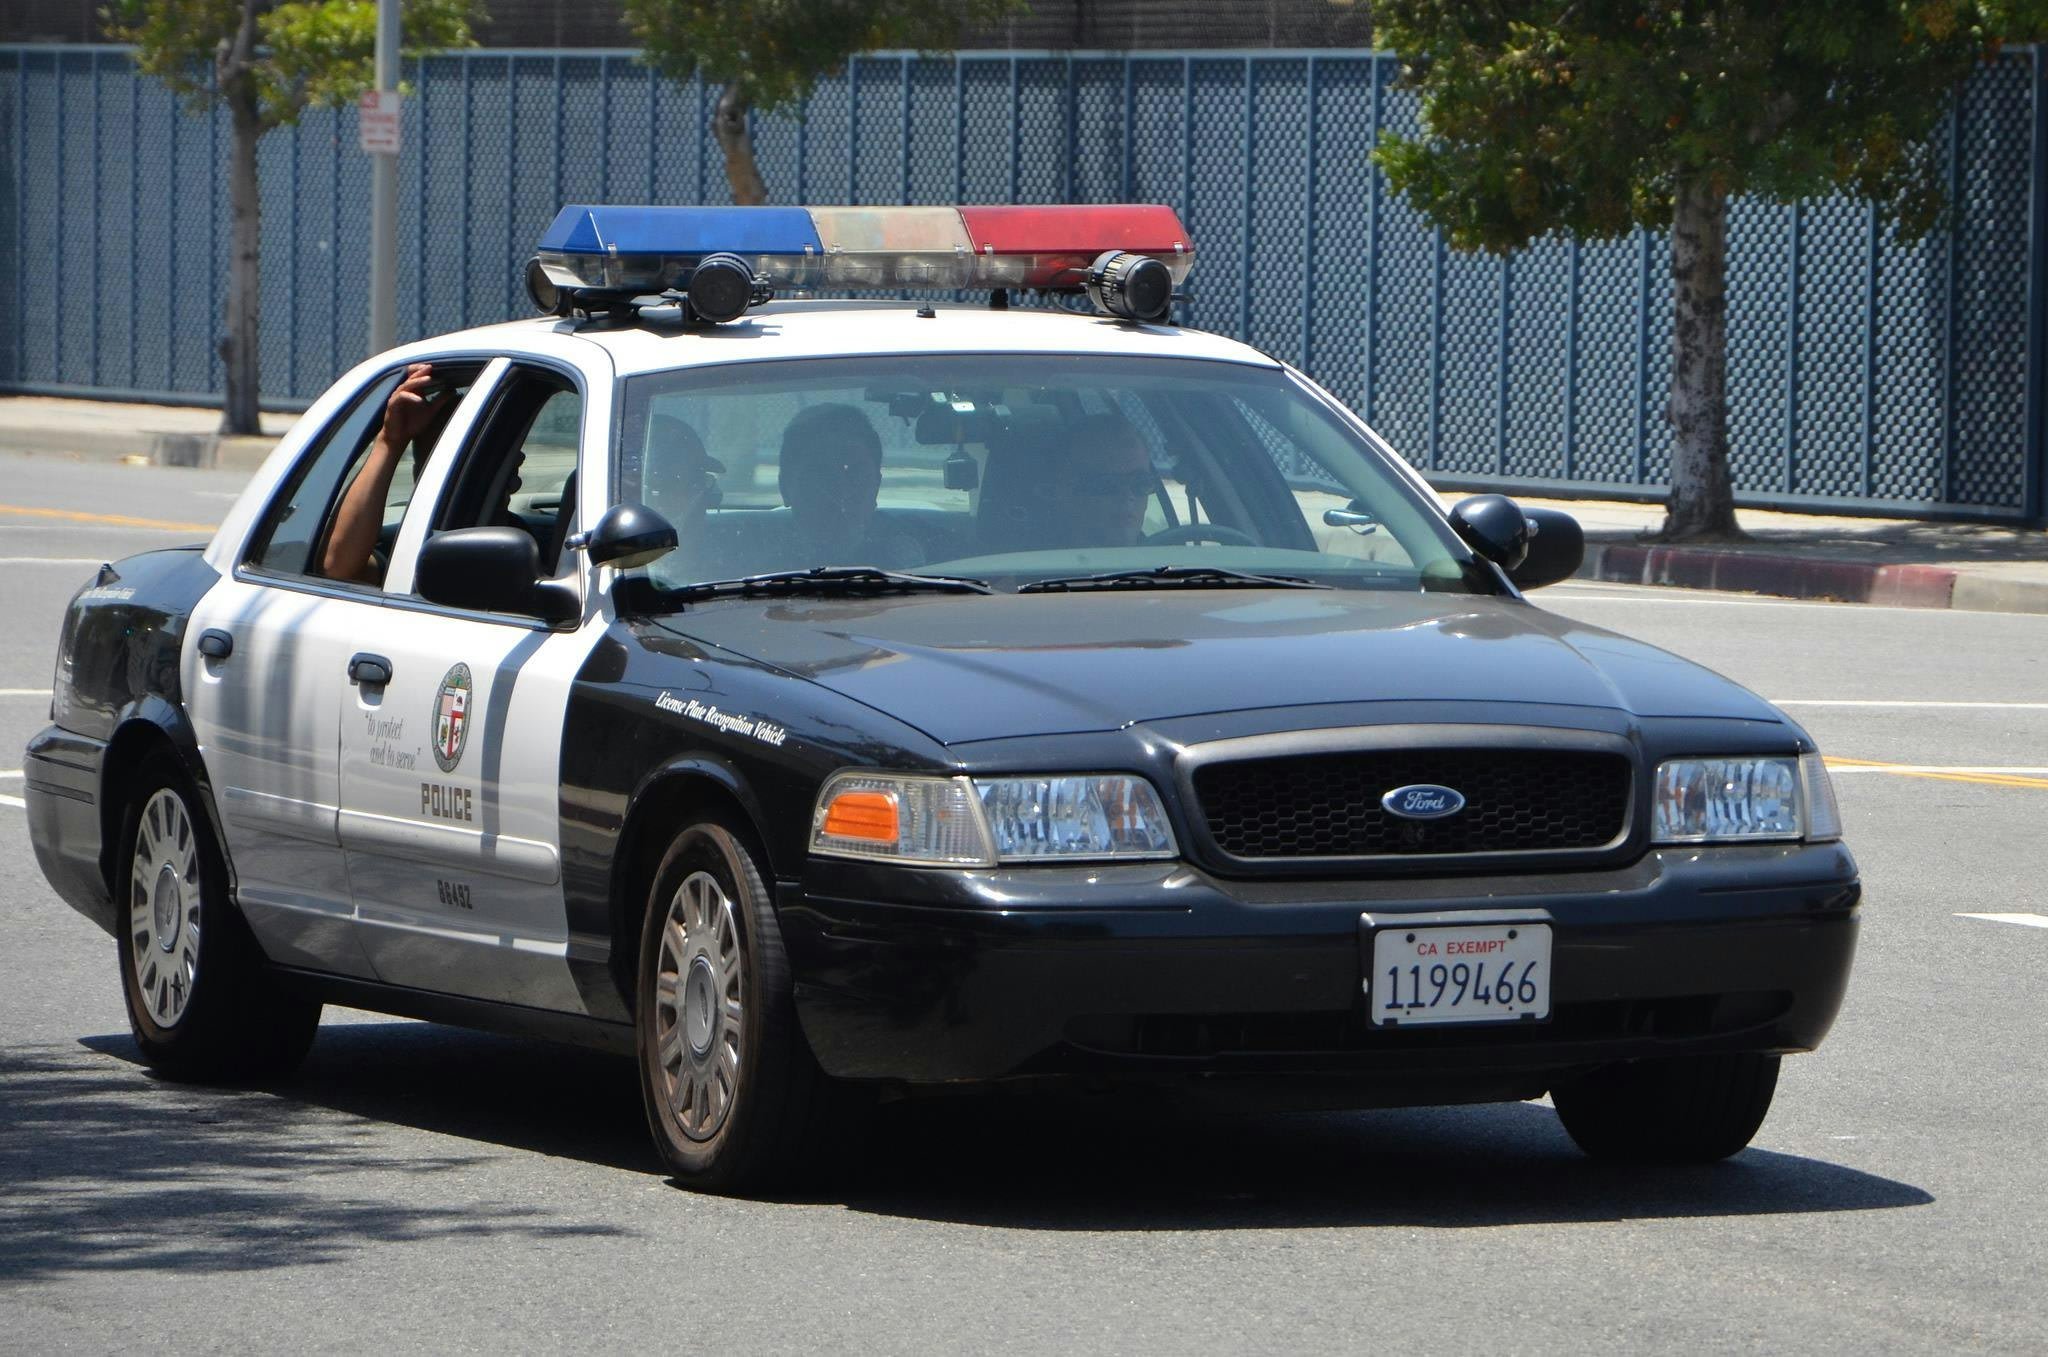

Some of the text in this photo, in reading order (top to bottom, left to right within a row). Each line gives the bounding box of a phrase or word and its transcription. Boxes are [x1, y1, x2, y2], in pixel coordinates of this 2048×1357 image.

[655, 690, 787, 747] License Plate Recognition Vehicle
[421, 782, 472, 822] POLICE
[1404, 790, 1445, 810] Ford
[1417, 939, 1507, 956] CA EXEMPT
[1385, 960, 1538, 1010] 1199466
